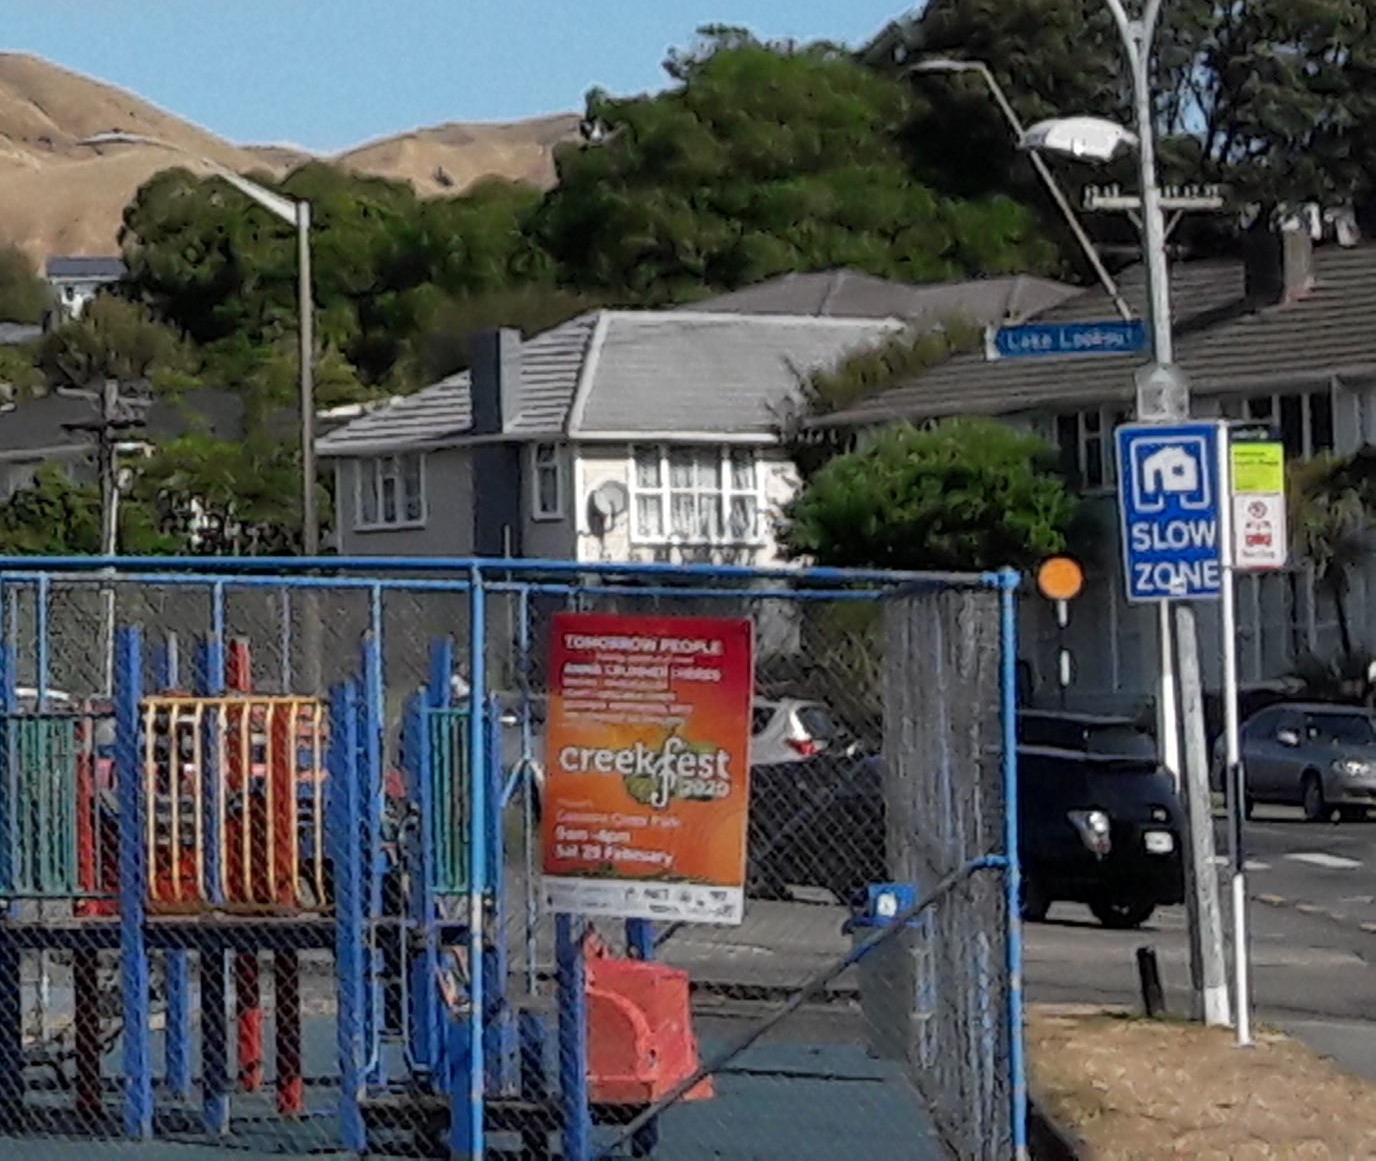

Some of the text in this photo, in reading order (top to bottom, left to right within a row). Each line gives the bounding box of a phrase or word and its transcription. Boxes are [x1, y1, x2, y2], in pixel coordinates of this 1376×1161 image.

[1131, 520, 1216, 551] SLOW
[1134, 559, 1221, 591] ZONE
[660, 638, 723, 657] PEOPLE
[559, 736, 731, 808] creekfest
[682, 781, 729, 797] 2020
